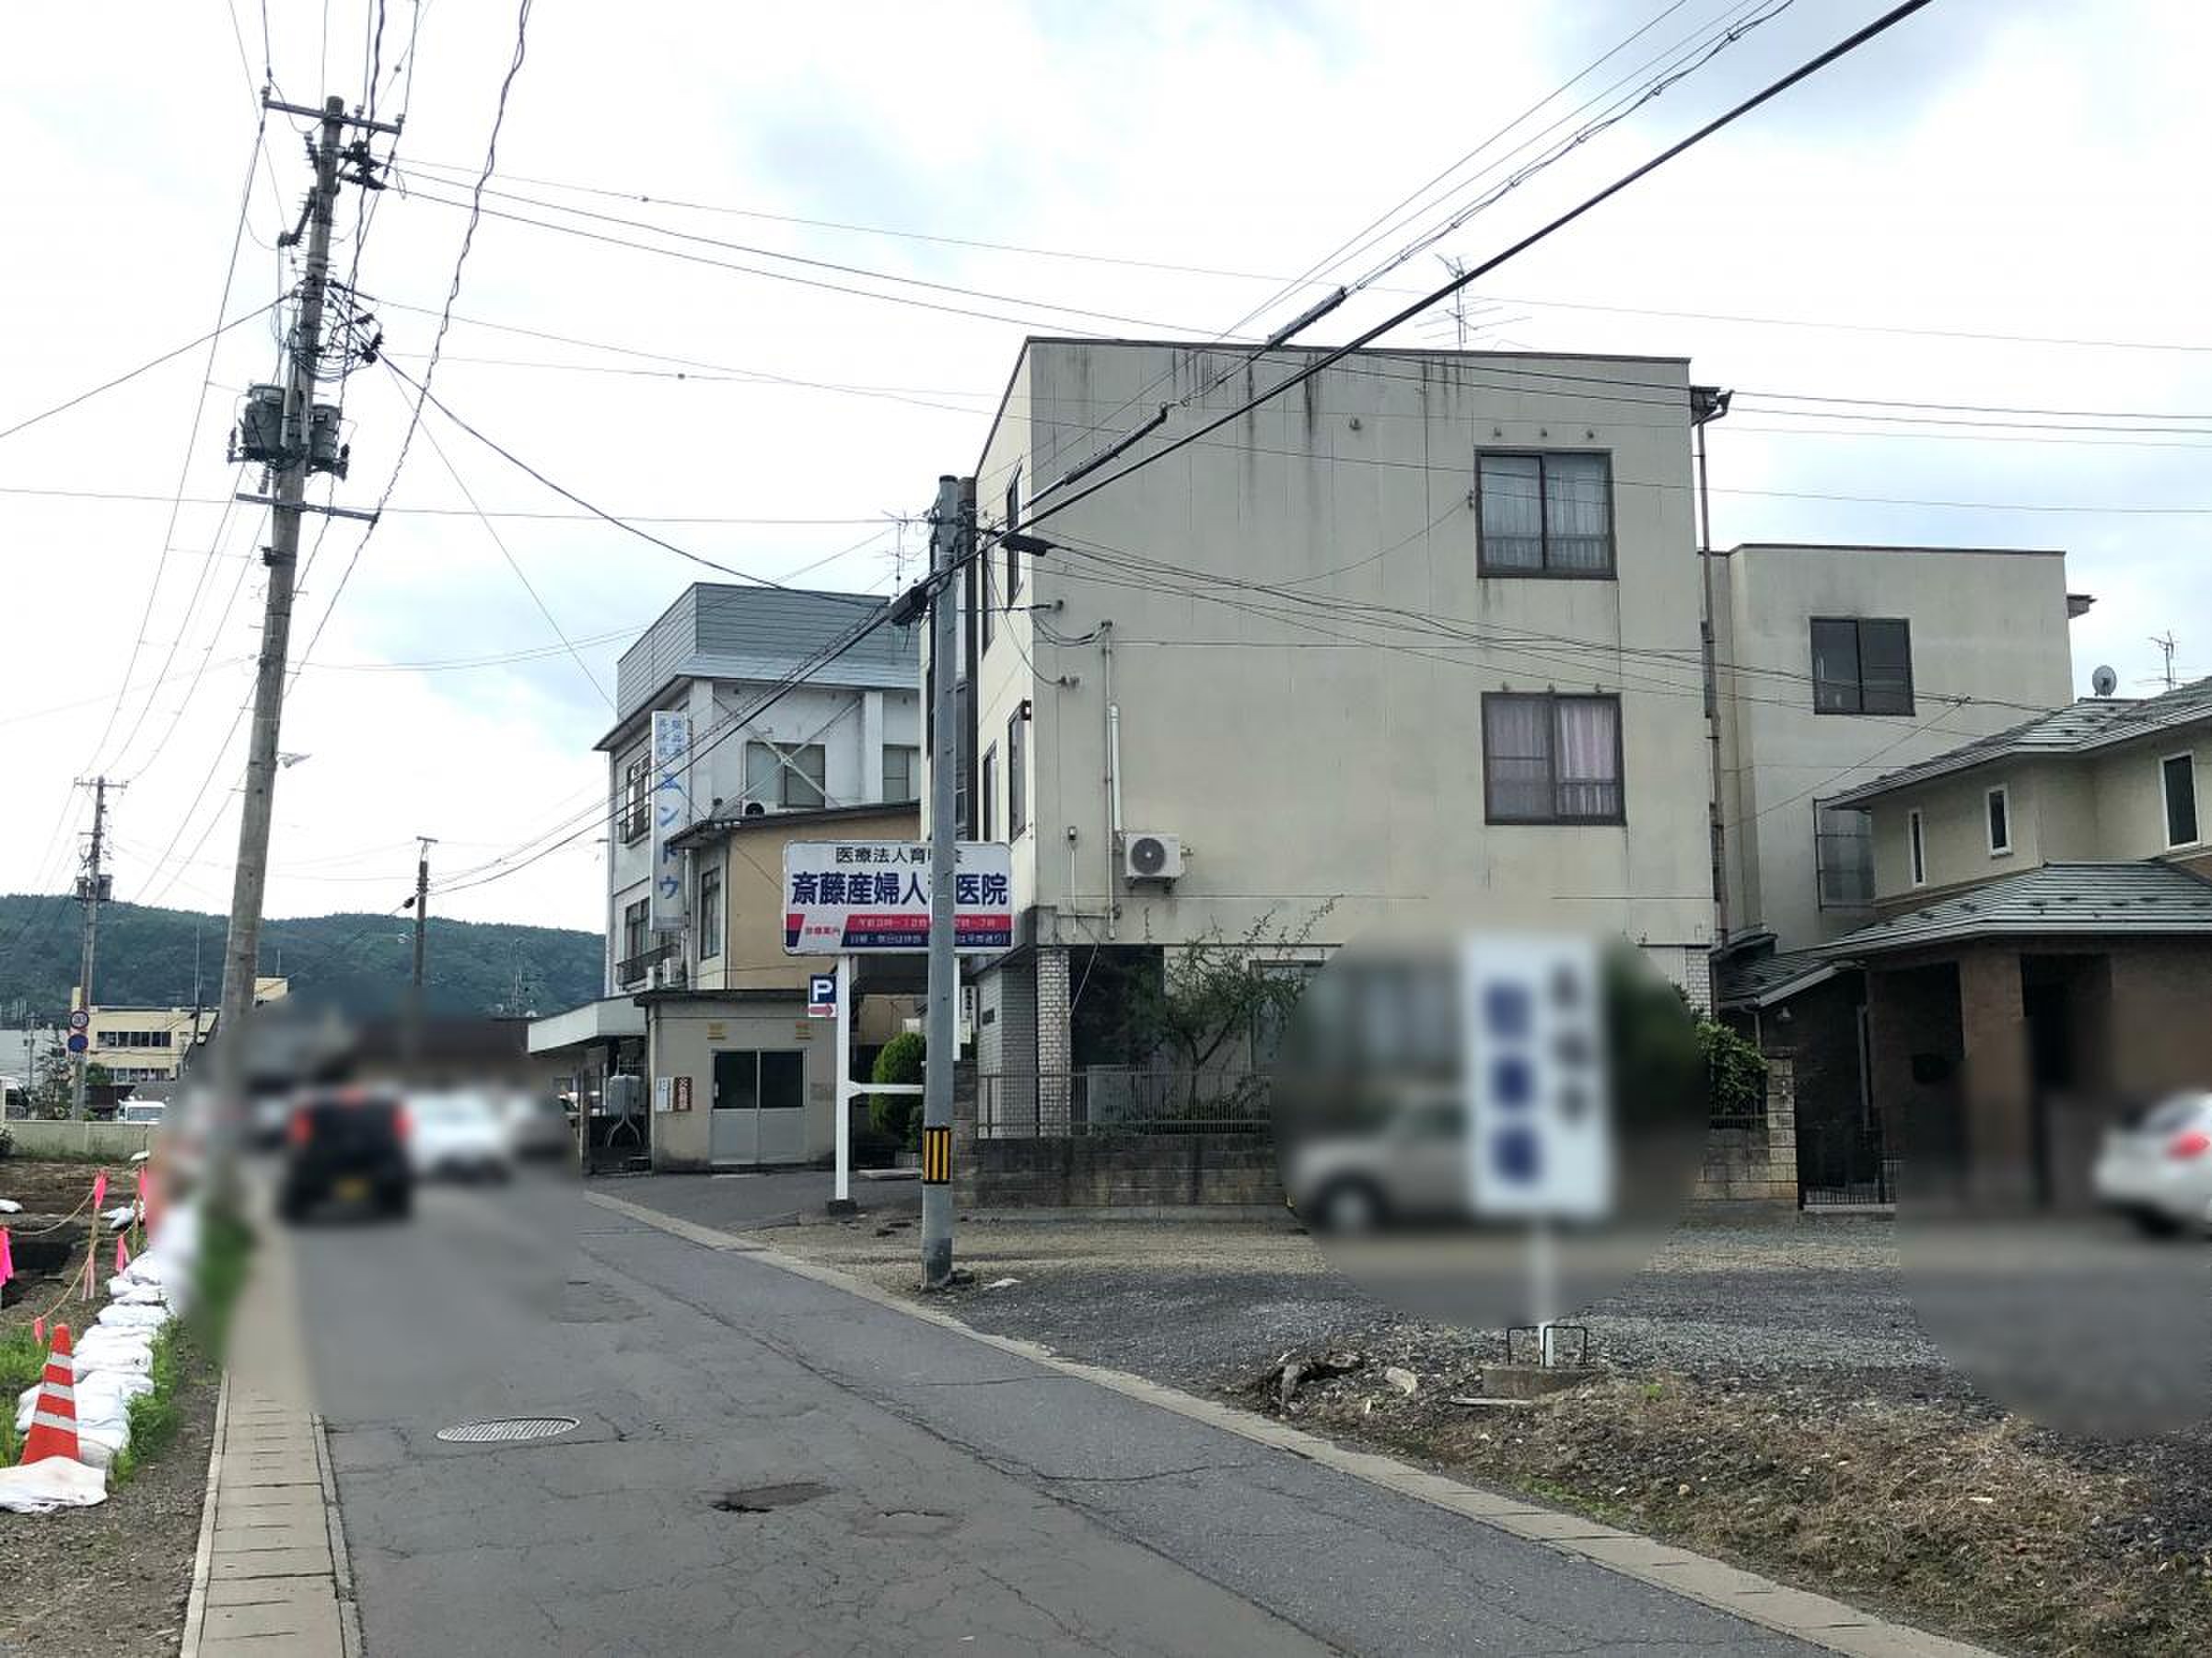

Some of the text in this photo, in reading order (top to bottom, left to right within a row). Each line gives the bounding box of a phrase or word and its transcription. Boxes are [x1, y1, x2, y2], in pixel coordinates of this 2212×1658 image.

[836, 847, 962, 864] 医療法人育
[791, 872, 1007, 905] 斎藤産婦人医院
[813, 979, 833, 1002] P
